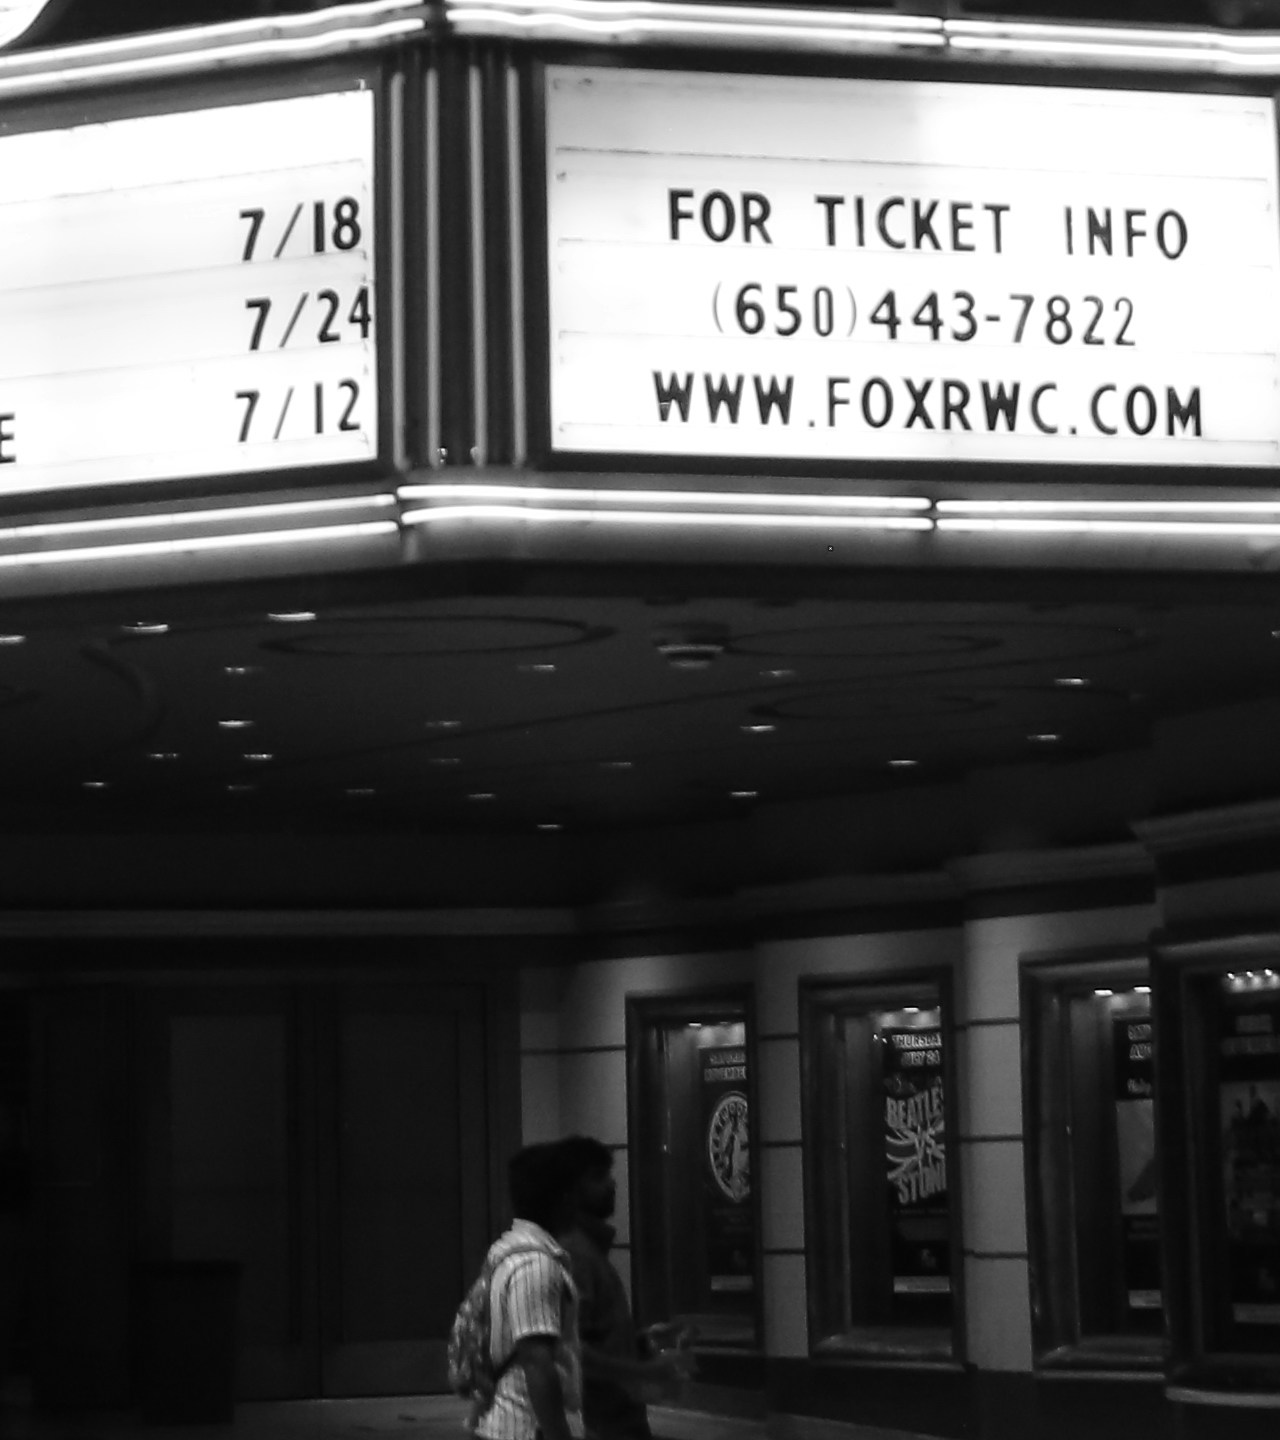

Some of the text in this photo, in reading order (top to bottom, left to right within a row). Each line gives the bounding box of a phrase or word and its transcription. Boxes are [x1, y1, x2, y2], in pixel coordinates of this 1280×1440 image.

[238, 195, 363, 262] 7/18
[667, 187, 1190, 261] FOR TICKET INFO
[244, 286, 373, 352] 7/24
[710, 281, 1137, 347] (650)443-7822
[234, 377, 362, 444] 7/12
[651, 369, 1203, 438] WWW.FOXRWC.COM
